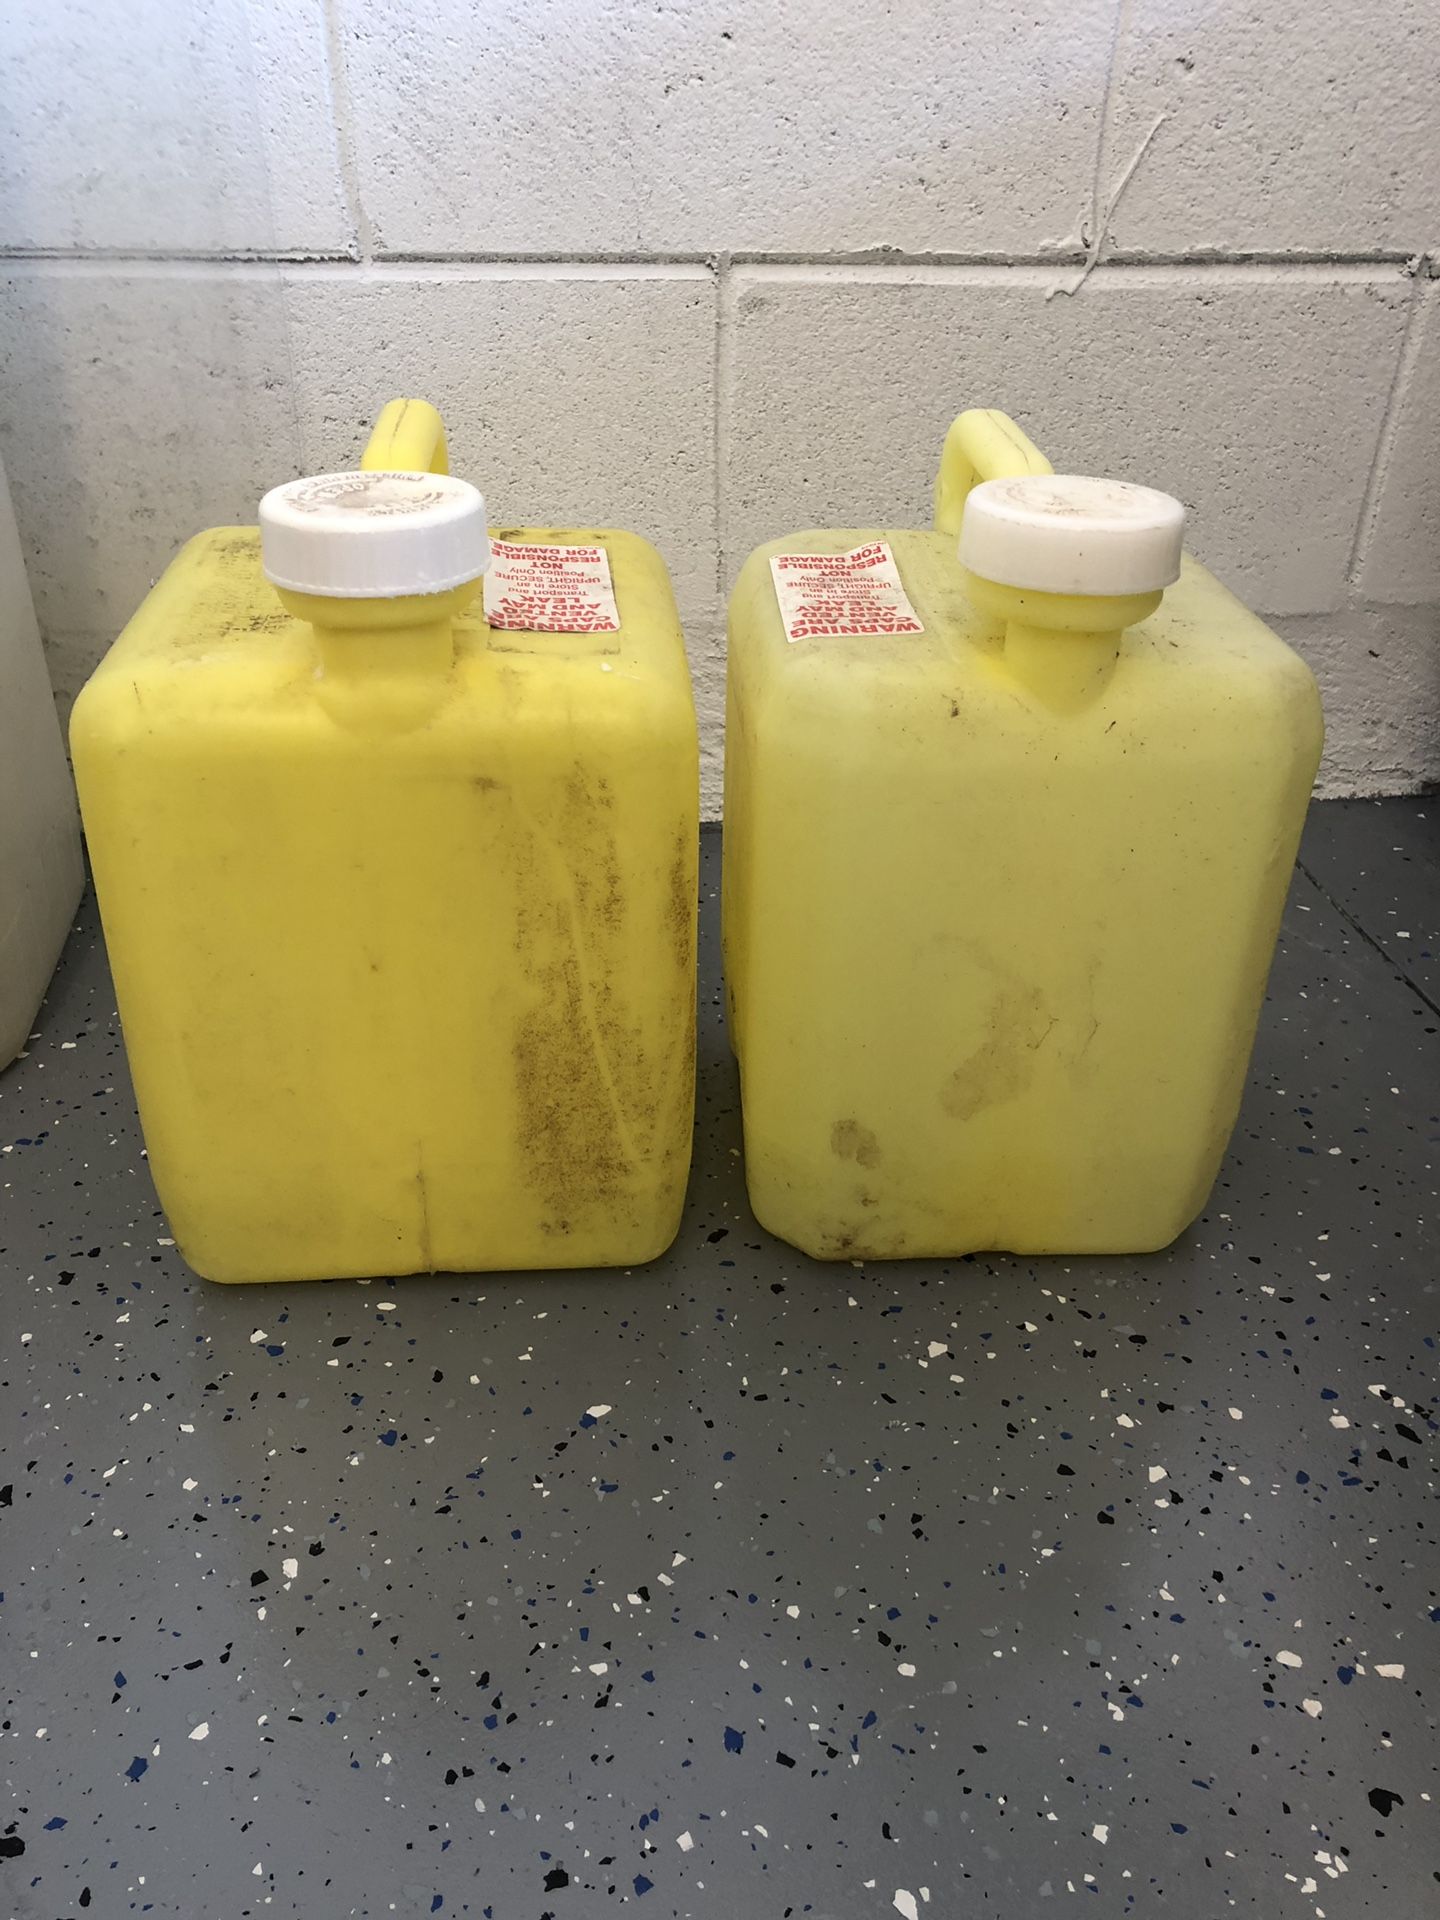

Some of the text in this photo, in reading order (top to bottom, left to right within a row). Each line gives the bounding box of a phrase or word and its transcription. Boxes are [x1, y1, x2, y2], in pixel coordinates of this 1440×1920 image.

[493, 542, 559, 554] DAMAGE
[850, 546, 881, 561] FOR
[491, 548, 601, 562] RESPONSIBLE
[778, 554, 887, 569] RESPONSIBLE
[494, 572, 543, 582] SECURE
[499, 598, 546, 609] MAY
[520, 595, 580, 603] LEAK
[502, 607, 598, 616] VENTED
[488, 616, 616, 631] WARNING
[792, 619, 839, 627] ARE
[790, 623, 920, 638] WARNING
